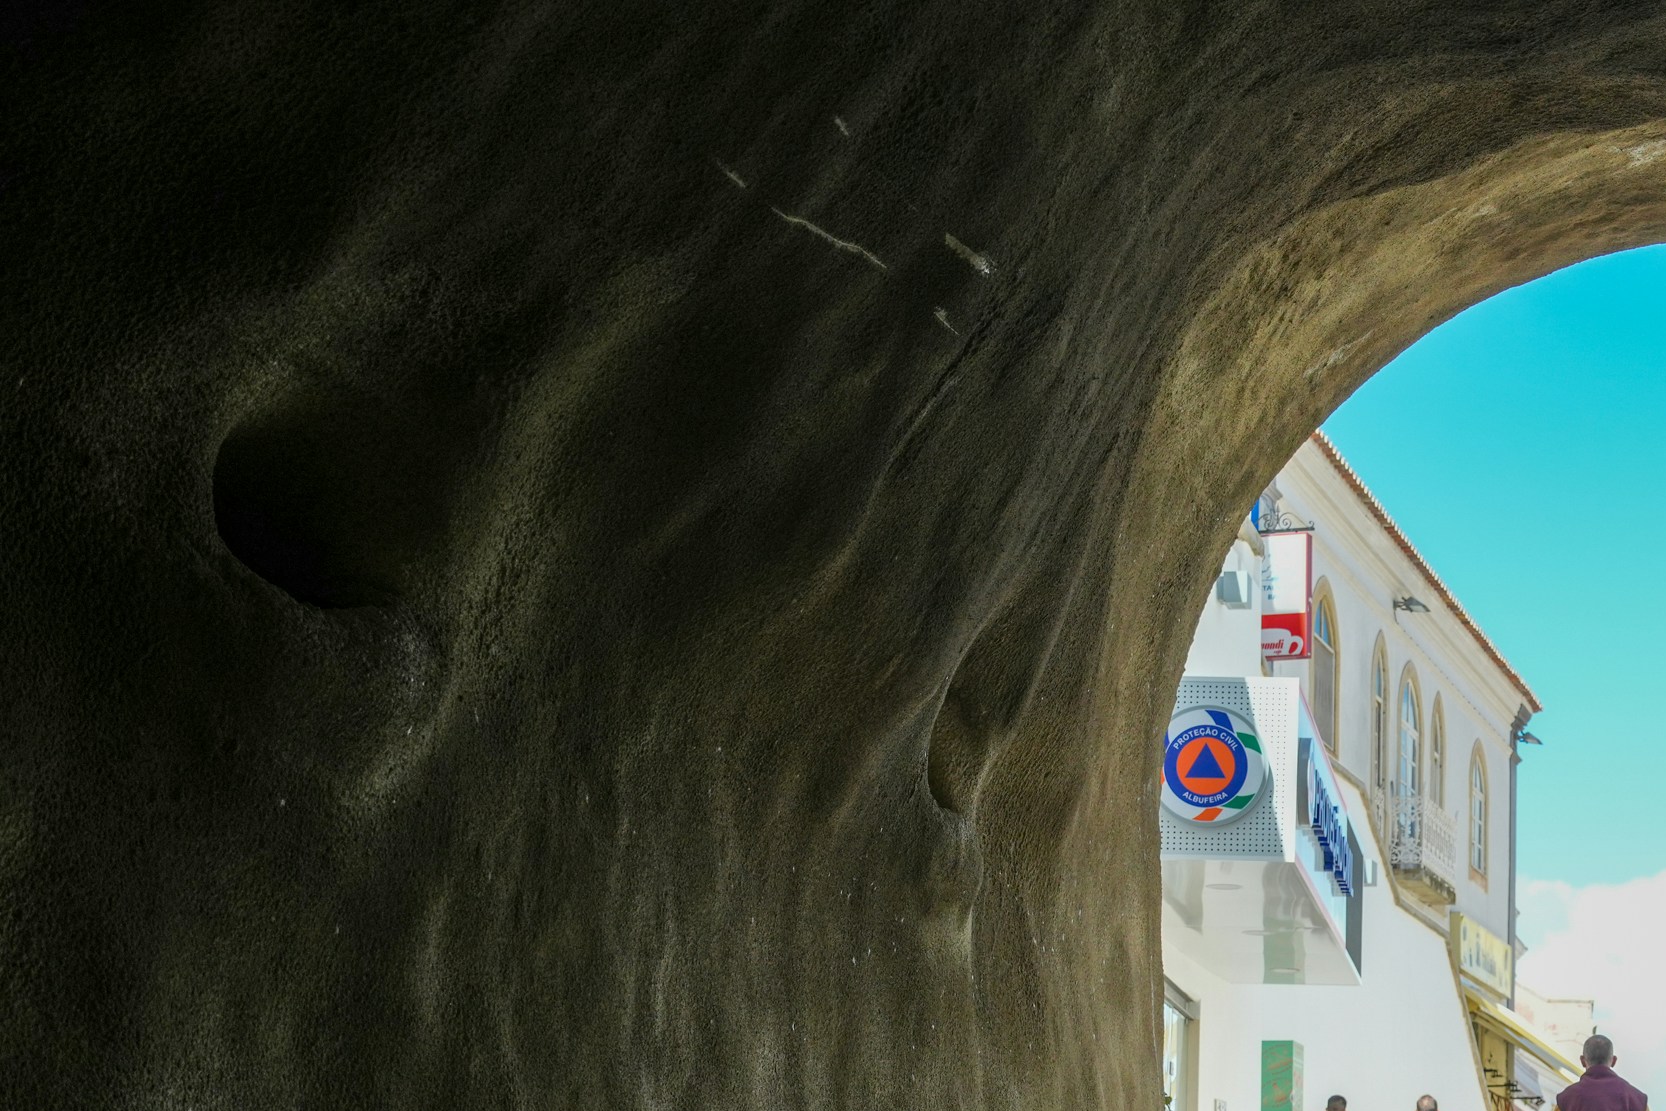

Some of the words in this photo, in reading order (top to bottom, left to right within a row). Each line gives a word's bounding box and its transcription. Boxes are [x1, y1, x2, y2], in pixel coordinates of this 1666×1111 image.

[1173, 727, 1218, 750] PROTEÇÃO
[1220, 732, 1239, 751] CIVIL
[1182, 791, 1229, 804] ALBUFEIRA
